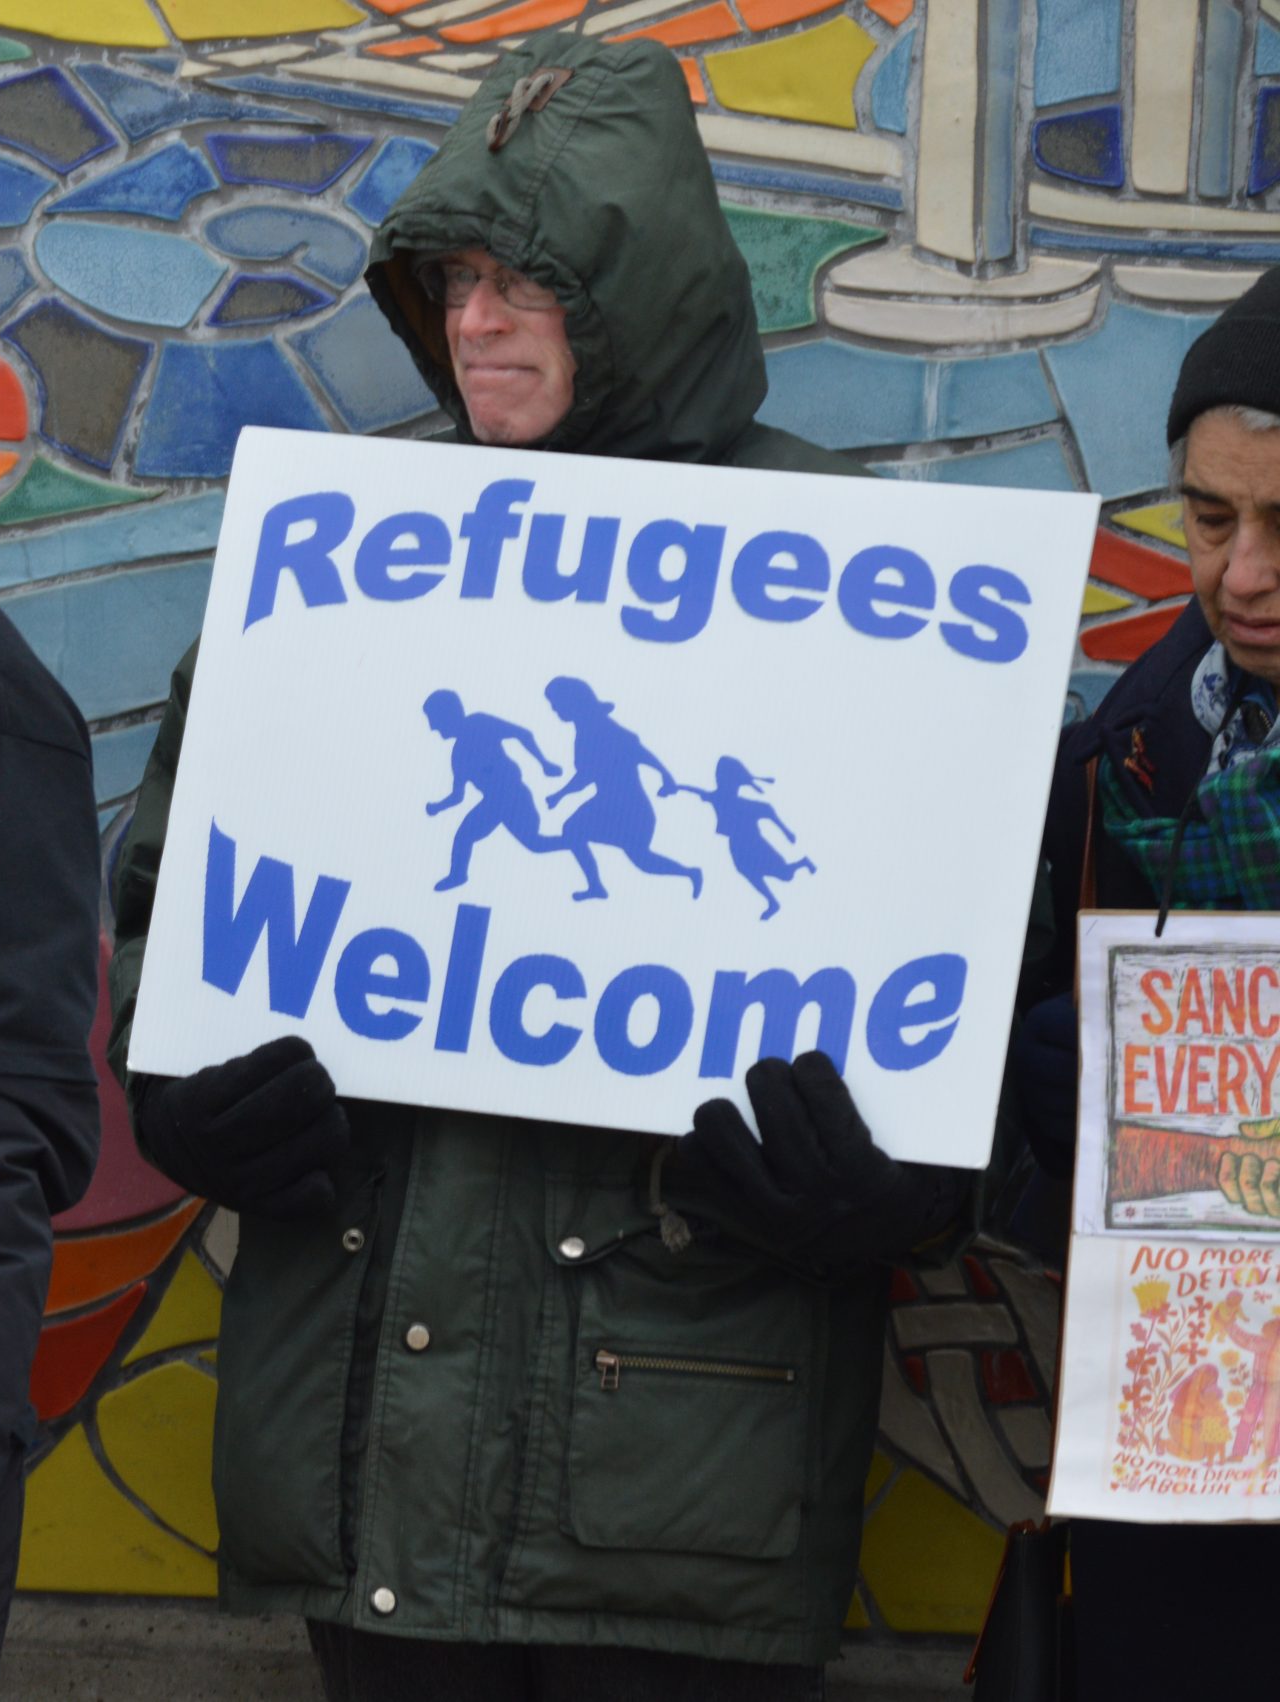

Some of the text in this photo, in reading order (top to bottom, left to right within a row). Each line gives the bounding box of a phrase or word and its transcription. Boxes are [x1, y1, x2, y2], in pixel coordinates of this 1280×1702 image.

[242, 478, 1032, 664] Refugees
[202, 815, 969, 1079] Welcome
[1140, 965, 1280, 1038] SANC
[1123, 1042, 1280, 1116] EVERY
[1130, 1245, 1190, 1276] NO
